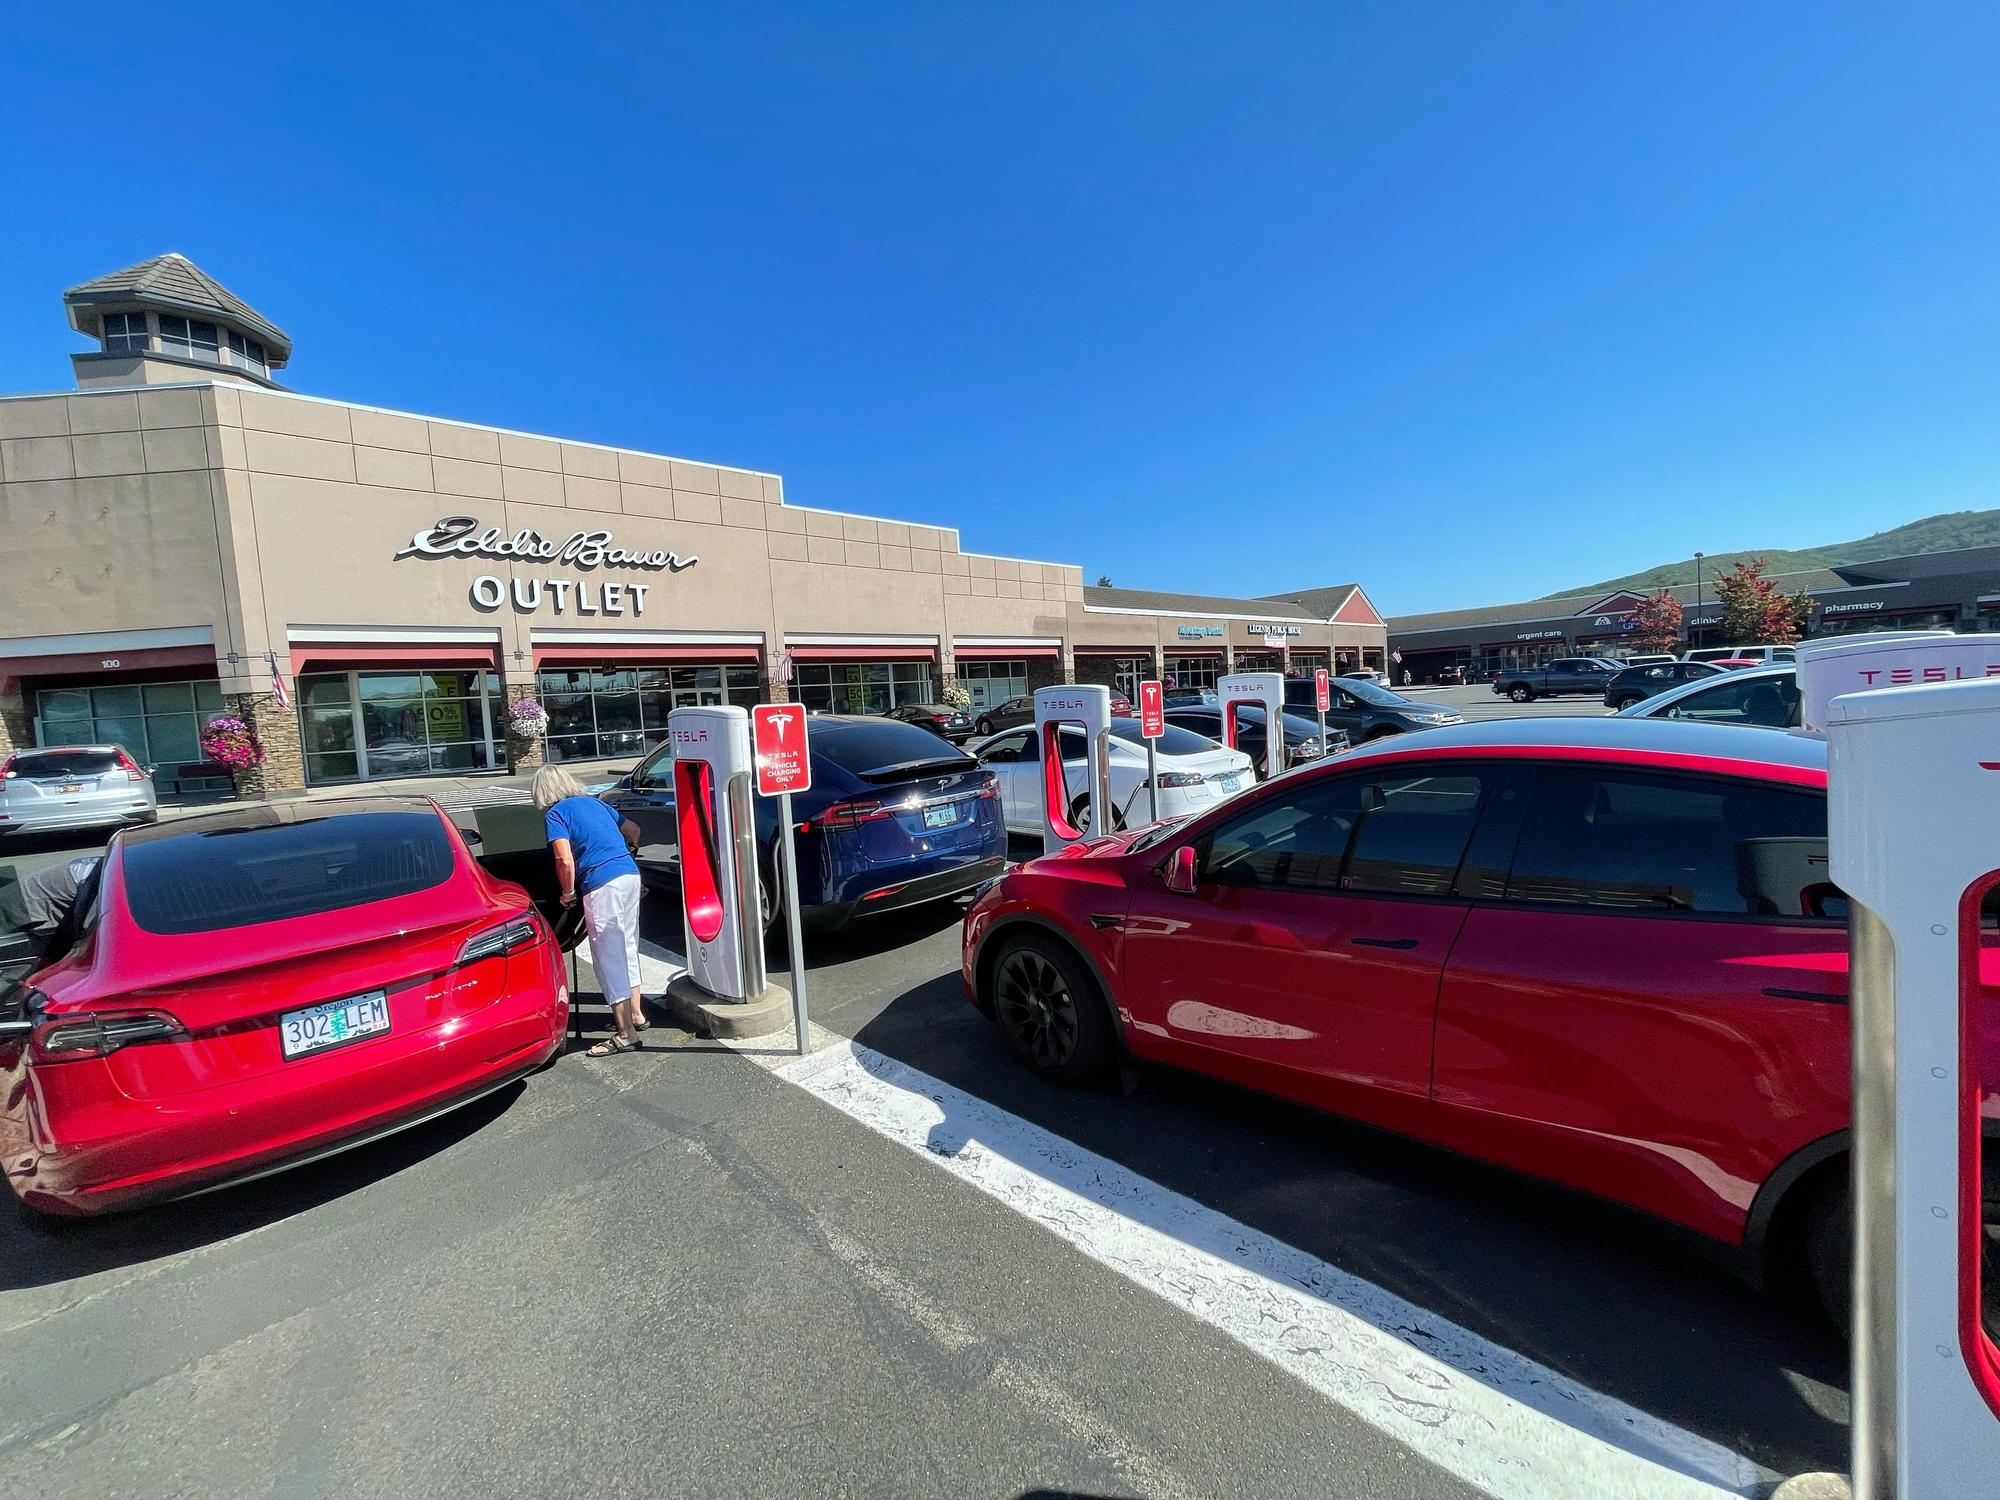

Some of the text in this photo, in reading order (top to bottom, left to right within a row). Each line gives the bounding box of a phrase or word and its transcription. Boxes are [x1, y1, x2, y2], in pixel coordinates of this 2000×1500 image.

[397, 516, 699, 566] Eddie Bauer
[472, 575, 649, 612] OUTLET
[1824, 602, 1884, 614] pharmacy
[1517, 631, 1543, 640] urgent
[101, 659, 120, 669] 100
[1227, 684, 1264, 692] TESLA
[1043, 700, 1083, 709] TESLA
[672, 730, 708, 742] TESLA
[768, 751, 798, 760] TESLA
[769, 761, 798, 769] VEHICLE
[767, 768, 801, 777] CHARGING
[315, 999, 353, 1013] Oregon
[288, 1000, 385, 1043] 302 LEM
